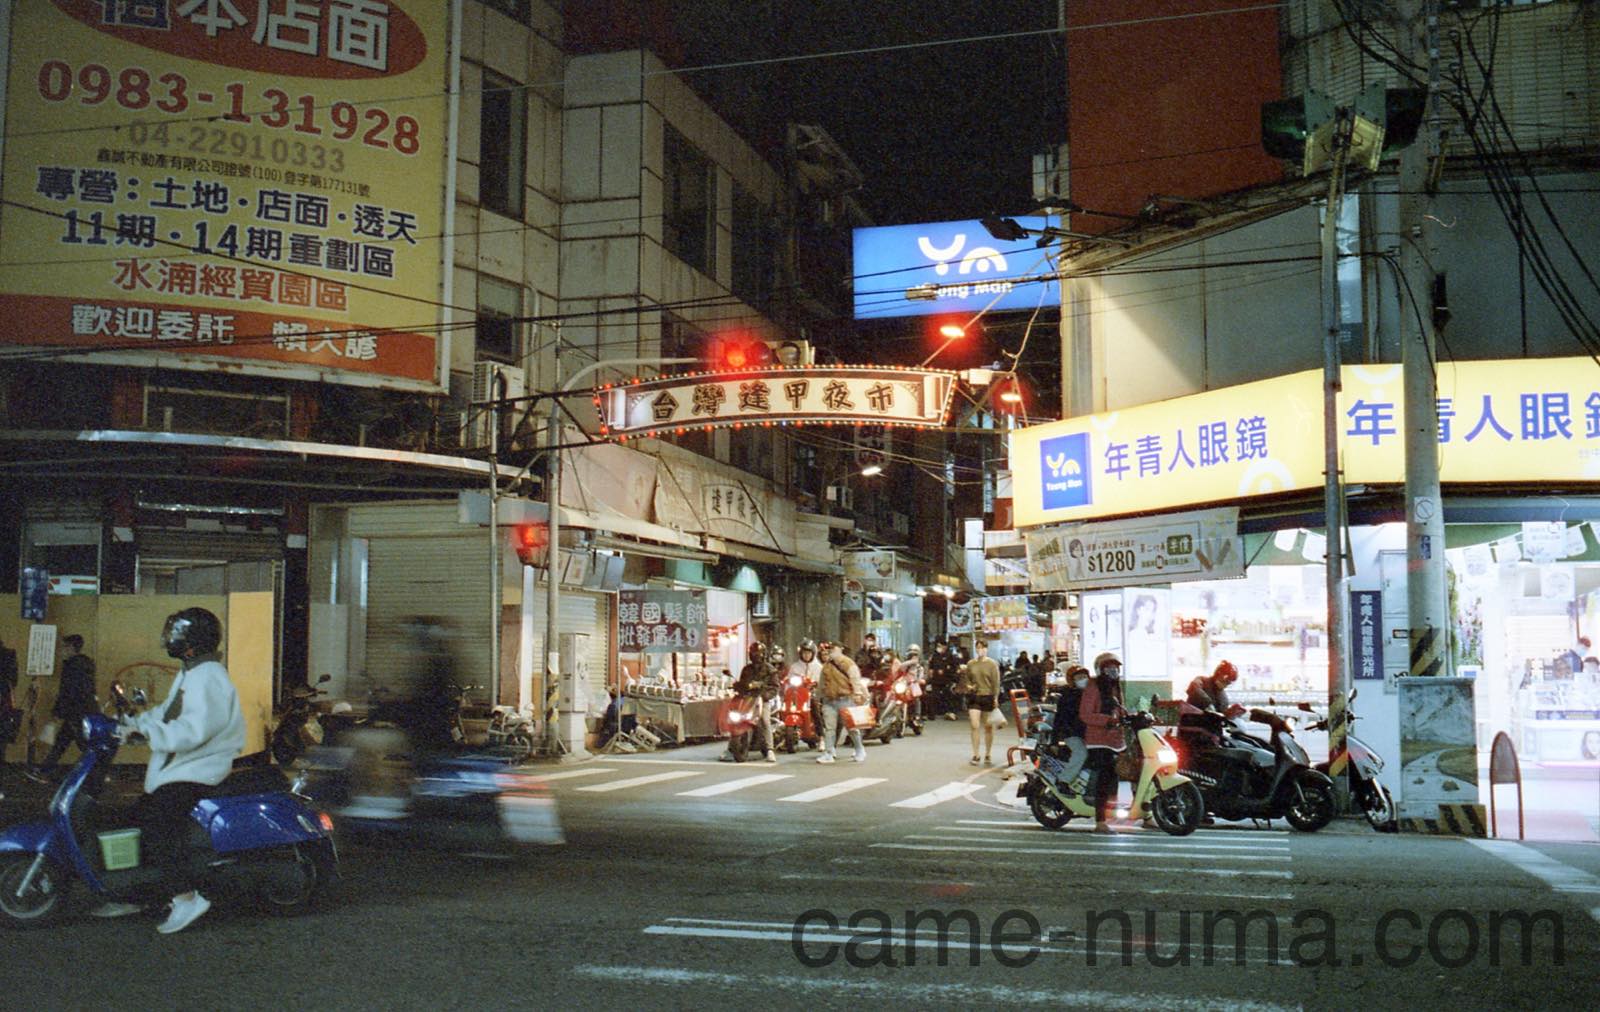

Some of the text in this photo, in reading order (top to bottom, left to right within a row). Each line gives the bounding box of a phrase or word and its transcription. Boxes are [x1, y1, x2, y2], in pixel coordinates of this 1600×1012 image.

[37, 60, 420, 154] 0983-131928
[112, 258, 348, 311] 水湳經貿園區
[72, 305, 235, 344] 歡迎委託
[652, 379, 894, 422] 台灣逢甲夜市
[1104, 416, 1268, 481] 年青人眼鏡
[1087, 550, 1135, 573] $1280
